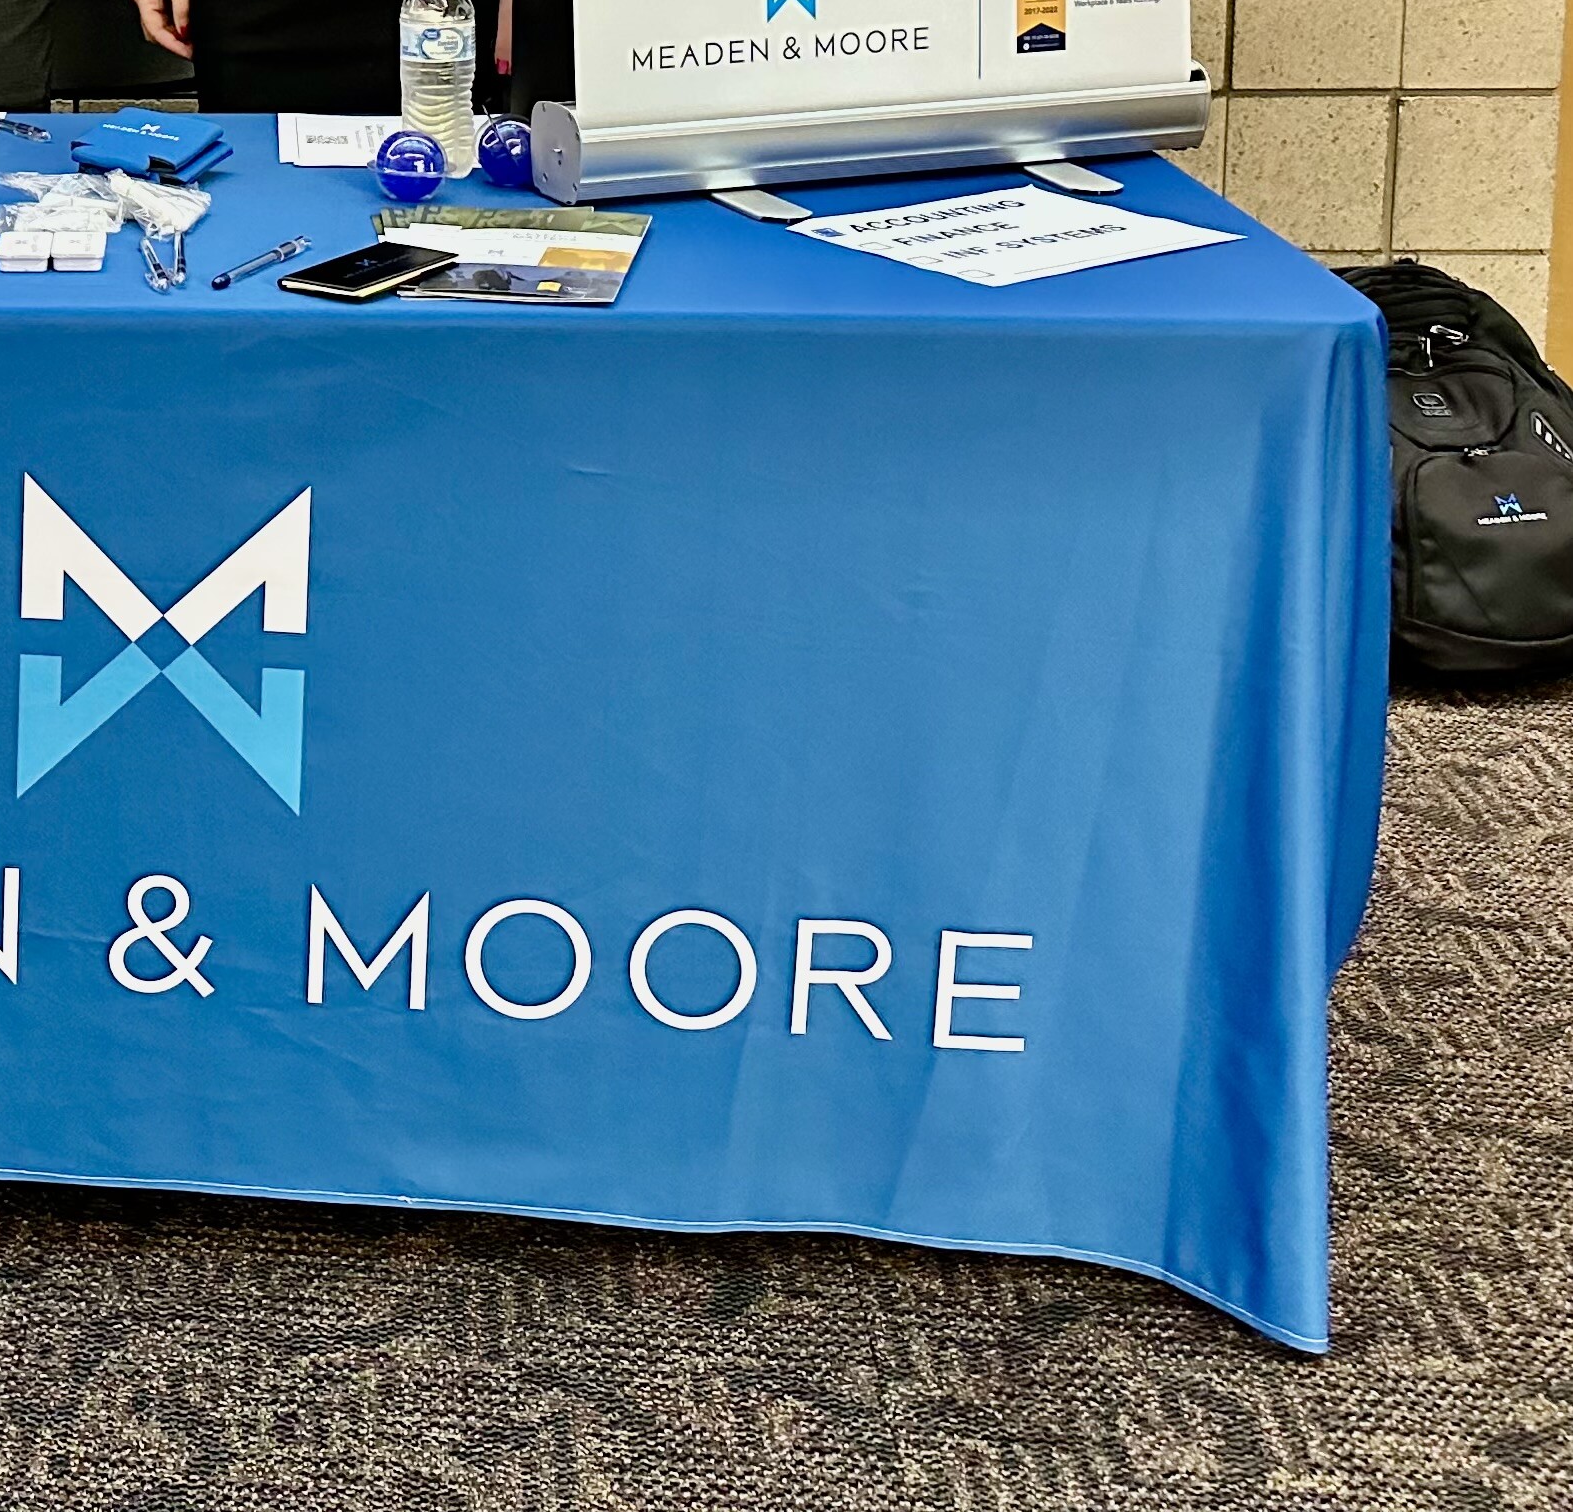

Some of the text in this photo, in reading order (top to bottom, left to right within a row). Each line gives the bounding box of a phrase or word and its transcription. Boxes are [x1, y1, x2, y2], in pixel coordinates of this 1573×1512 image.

[633, 27, 929, 71] MEADEN & MOORE
[850, 200, 1025, 232] ACCOUNTING
[893, 222, 1019, 246] FINANCE
[996, 225, 1127, 249] SYSTEMS
[107, 874, 215, 998] &
[306, 882, 1034, 1052] MOORE
